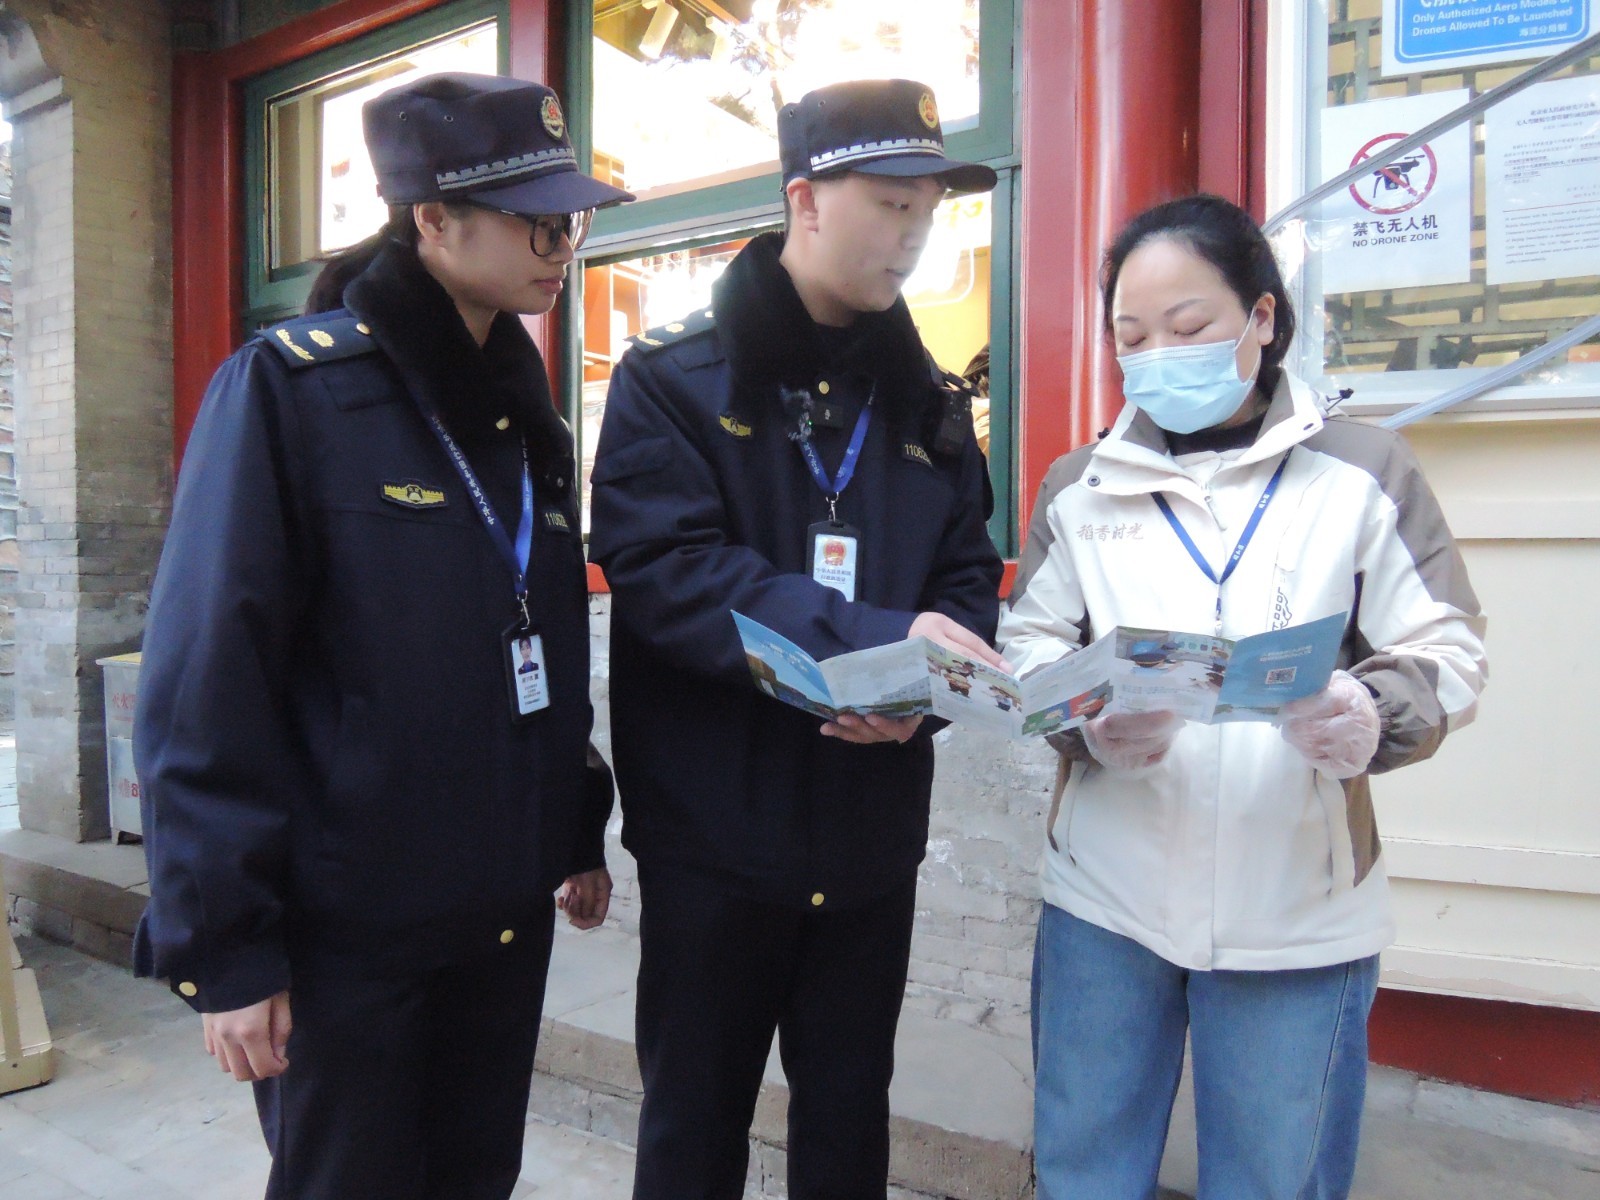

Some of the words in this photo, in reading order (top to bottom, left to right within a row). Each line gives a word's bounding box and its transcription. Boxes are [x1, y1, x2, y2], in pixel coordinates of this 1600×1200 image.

[1412, 13, 1435, 23] Only
[1438, 5, 1492, 20] Authorized
[1494, 3, 1518, 12] Aero
[1412, 25, 1447, 37] Drones
[1449, 18, 1490, 31] Allowed
[1492, 16, 1505, 26] To
[1507, 14, 1520, 24] Be
[1523, 6, 1573, 22] Launched
[1352, 214, 1438, 237] 禁飞无人机
[1352, 239, 1368, 248] NO
[1371, 235, 1407, 246] DRONE
[1409, 232, 1439, 242] ZONE
